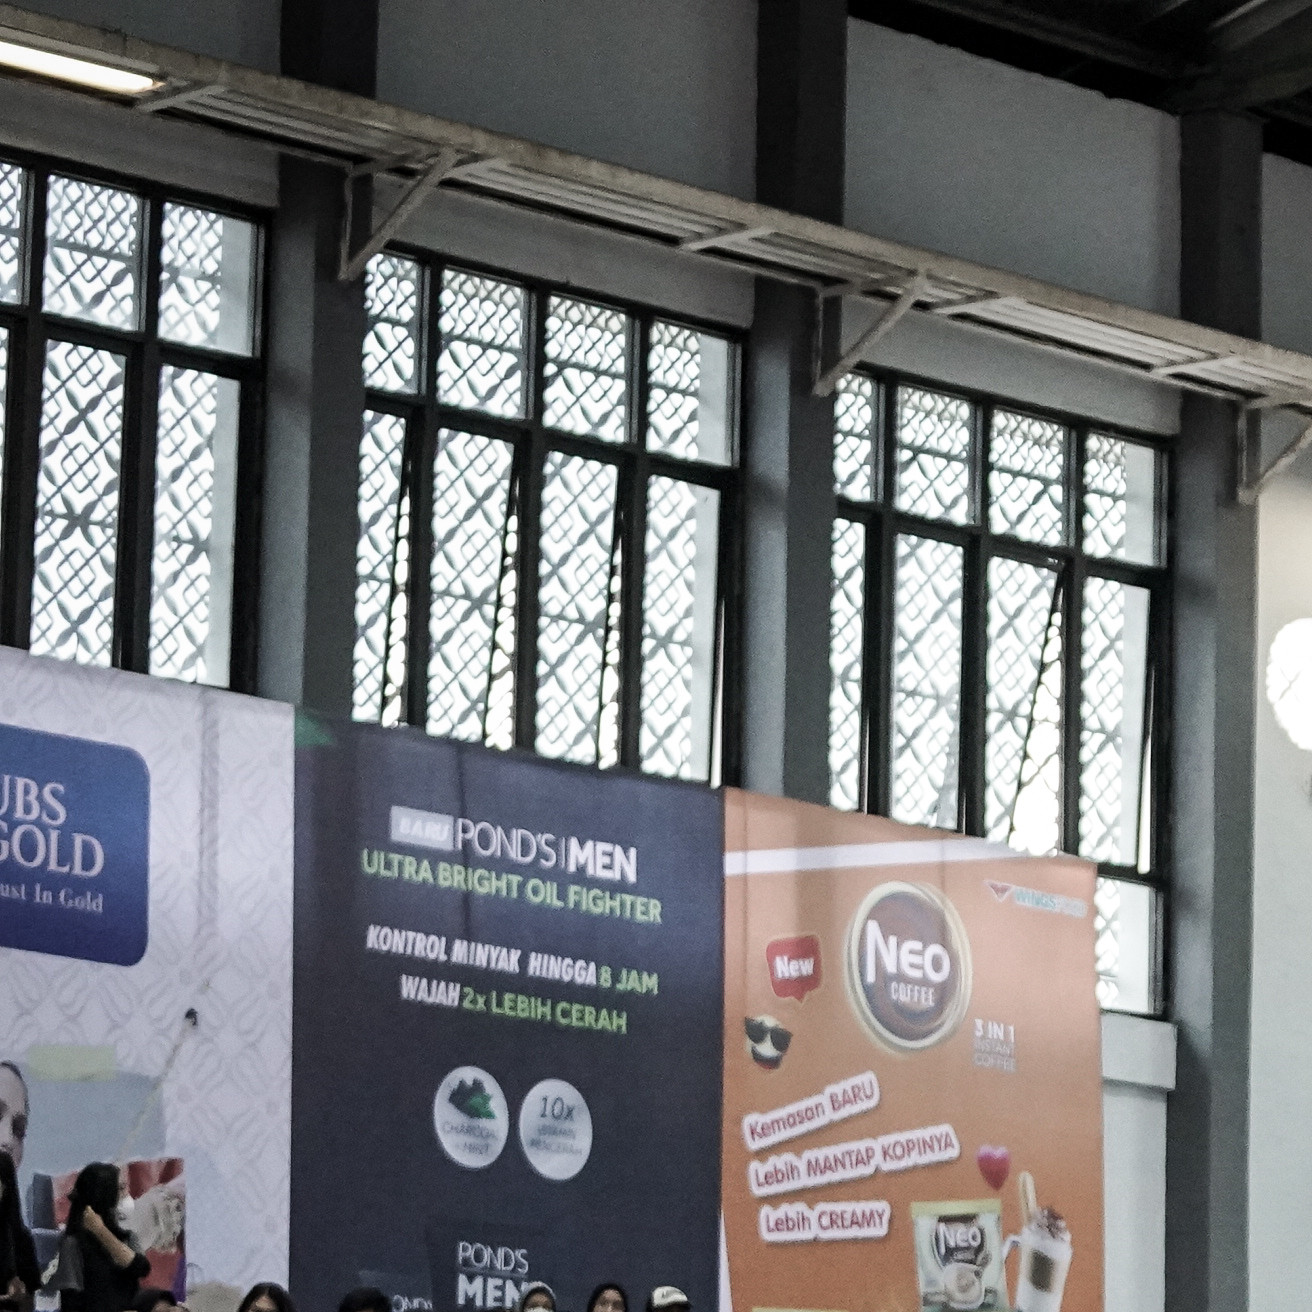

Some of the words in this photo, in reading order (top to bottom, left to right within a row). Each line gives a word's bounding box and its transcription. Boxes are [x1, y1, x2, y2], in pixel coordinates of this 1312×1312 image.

[0, 820, 104, 877] OLD
[456, 817, 557, 869] POND'S
[568, 836, 638, 884] MEN
[361, 848, 434, 884] ULTRA
[437, 861, 523, 900] BRIGHT
[525, 877, 565, 908] OIL
[568, 884, 662, 925] FIGHTER
[366, 923, 448, 962] KONTROL
[451, 938, 522, 974] MINYAK
[528, 951, 598, 986] HINGGA
[616, 967, 659, 997] JAM
[774, 954, 816, 980] New
[865, 919, 951, 984] NEO
[400, 973, 462, 1007] WAJAH
[462, 986, 487, 1012] 2x
[490, 990, 552, 1022] LEBIH
[555, 1001, 628, 1035] CERAH
[890, 979, 936, 1006] COFFEE
[988, 1020, 1004, 1040] IN
[540, 1094, 575, 1122] 10x
[749, 1101, 826, 1142] Kemasan
[829, 1080, 875, 1113] BARU
[755, 1160, 802, 1188] Lebih
[806, 1146, 876, 1178] MANTAP
[881, 1131, 955, 1163] KOPINYA
[765, 1212, 812, 1233] Lebih
[817, 1209, 886, 1232] CREAMY
